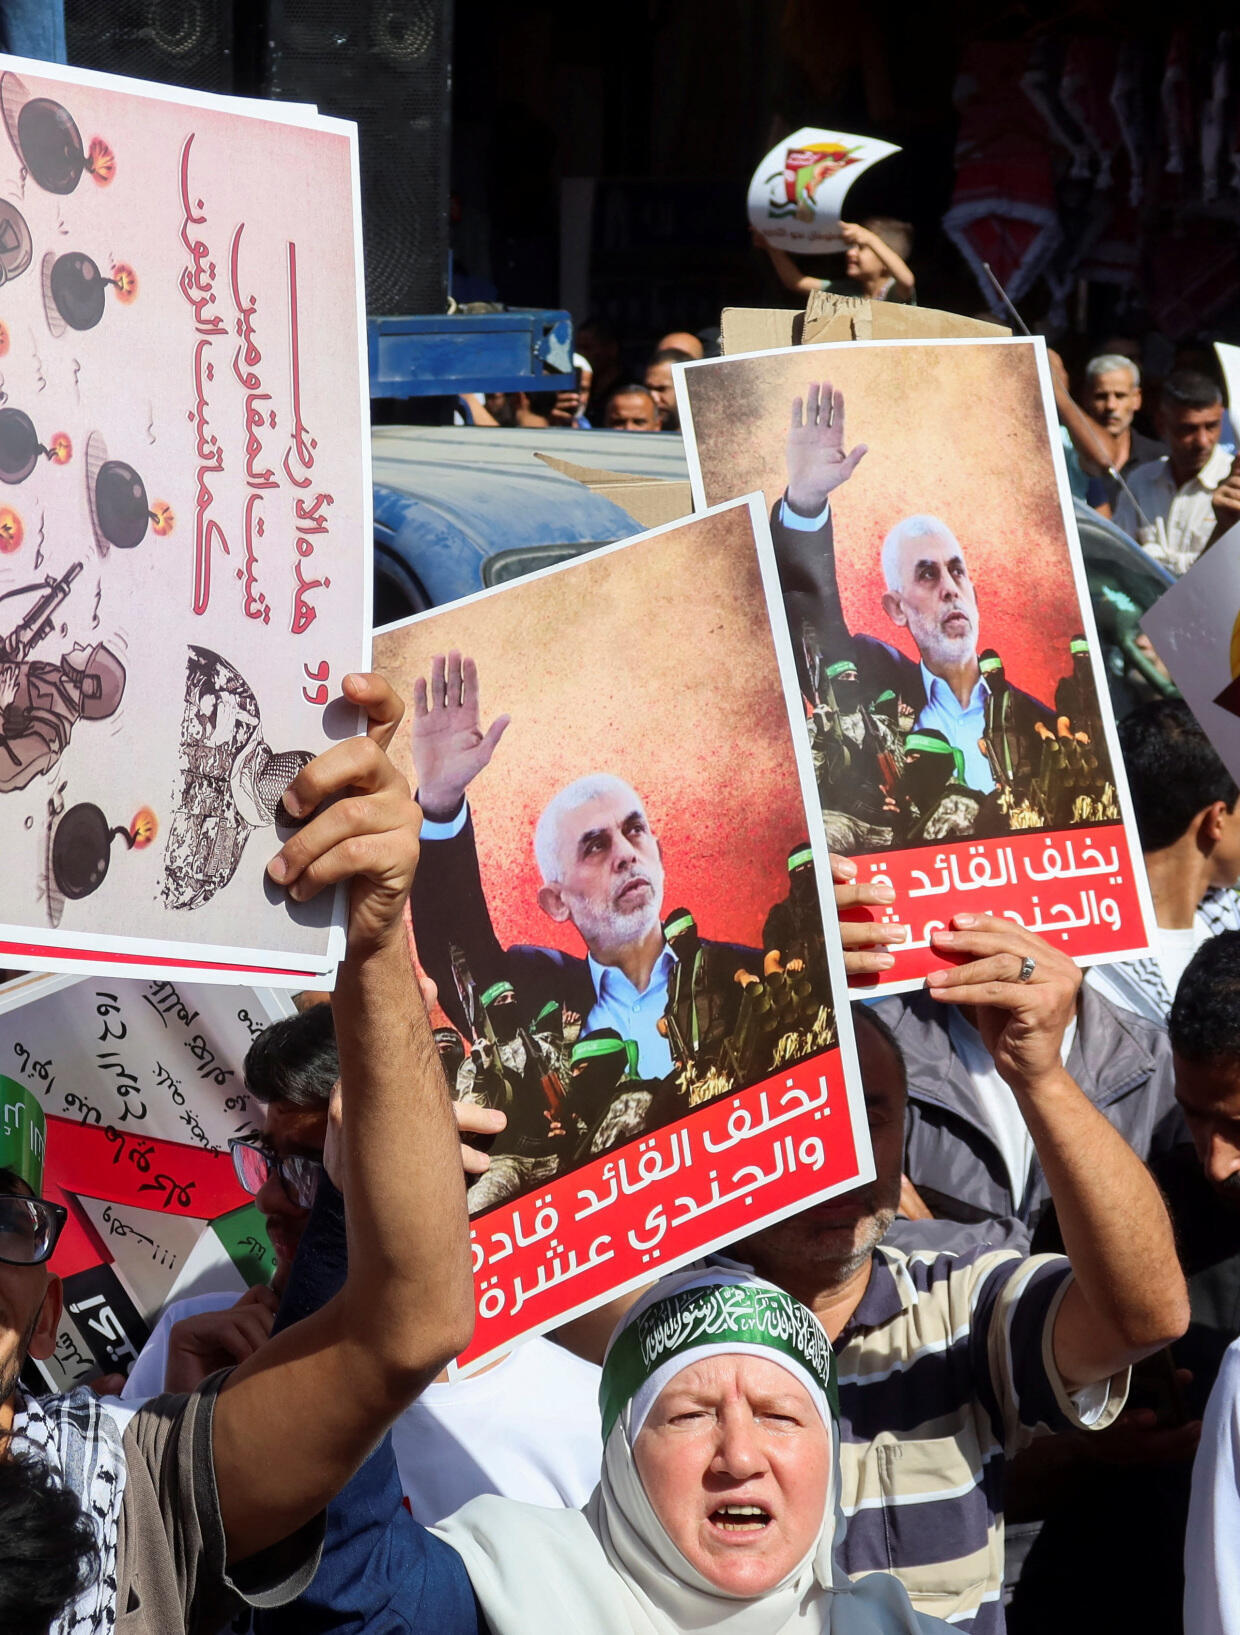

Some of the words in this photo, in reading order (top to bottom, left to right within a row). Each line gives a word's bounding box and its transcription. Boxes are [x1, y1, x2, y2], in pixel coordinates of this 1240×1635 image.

[180, 132, 229, 336] الزيتون
[230, 222, 280, 488] المقاومين
[235, 493, 271, 625] تنبت
[291, 538, 331, 634] هذه
[909, 845, 1018, 897] القائد
[1023, 837, 1123, 884] يخلف
[95, 991, 127, 1042] روح
[13, 1042, 55, 1095] ماتوا
[62, 1092, 103, 1127] قبل
[95, 1052, 148, 1122] الروح
[703, 1075, 832, 1153] يخلف
[574, 1129, 693, 1221] القائد
[627, 1135, 826, 1263] والجندي
[477, 1234, 616, 1320] عشرة
